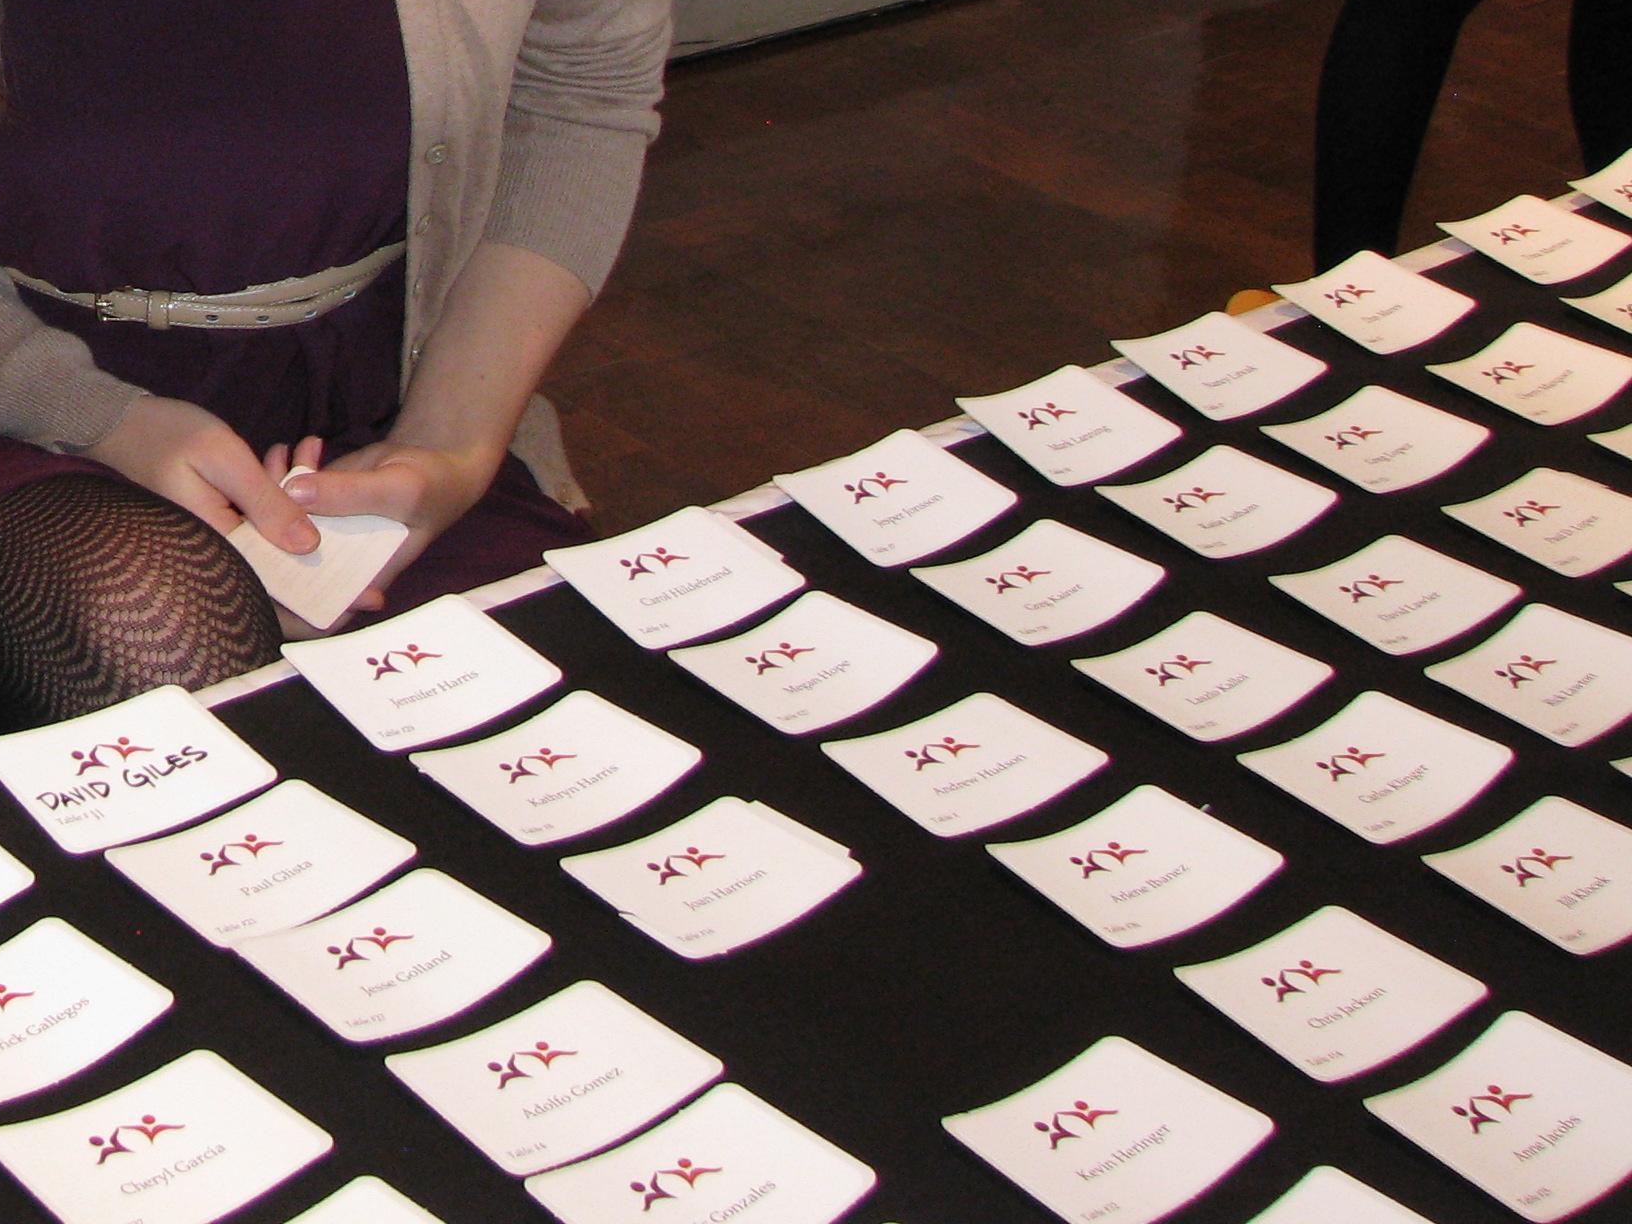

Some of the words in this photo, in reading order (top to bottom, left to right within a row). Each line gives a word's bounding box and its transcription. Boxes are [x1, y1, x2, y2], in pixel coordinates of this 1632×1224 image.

[389, 685, 438, 710] Jennifer
[435, 669, 480, 693] Harris
[817, 660, 851, 681] Hope
[35, 780, 111, 811] DAVID
[122, 745, 209, 789] GILES
[526, 784, 580, 808] Kathryn
[576, 763, 620, 789] Harris
[240, 876, 274, 898] Paul
[271, 859, 314, 885] Glista
[710, 868, 768, 900] Harrison
[359, 977, 397, 998] Jesse
[394, 949, 452, 983] Golland
[25, 996, 91, 1037] Gallegos
[1307, 1009, 1344, 1030] Chris
[1337, 986, 1388, 1018] Jackson
[522, 1090, 572, 1120] Adolfo
[569, 1065, 624, 1098] Gomez
[1076, 1158, 1120, 1182] Kevin
[1111, 1123, 1171, 1164] Heringer
[1513, 1140, 1547, 1163] Anne
[1538, 1114, 1582, 1148] Jacobs
[120, 1166, 176, 1196] Cheryl
[172, 1142, 227, 1174] Garcia
[708, 1179, 777, 1224] Gonzales
